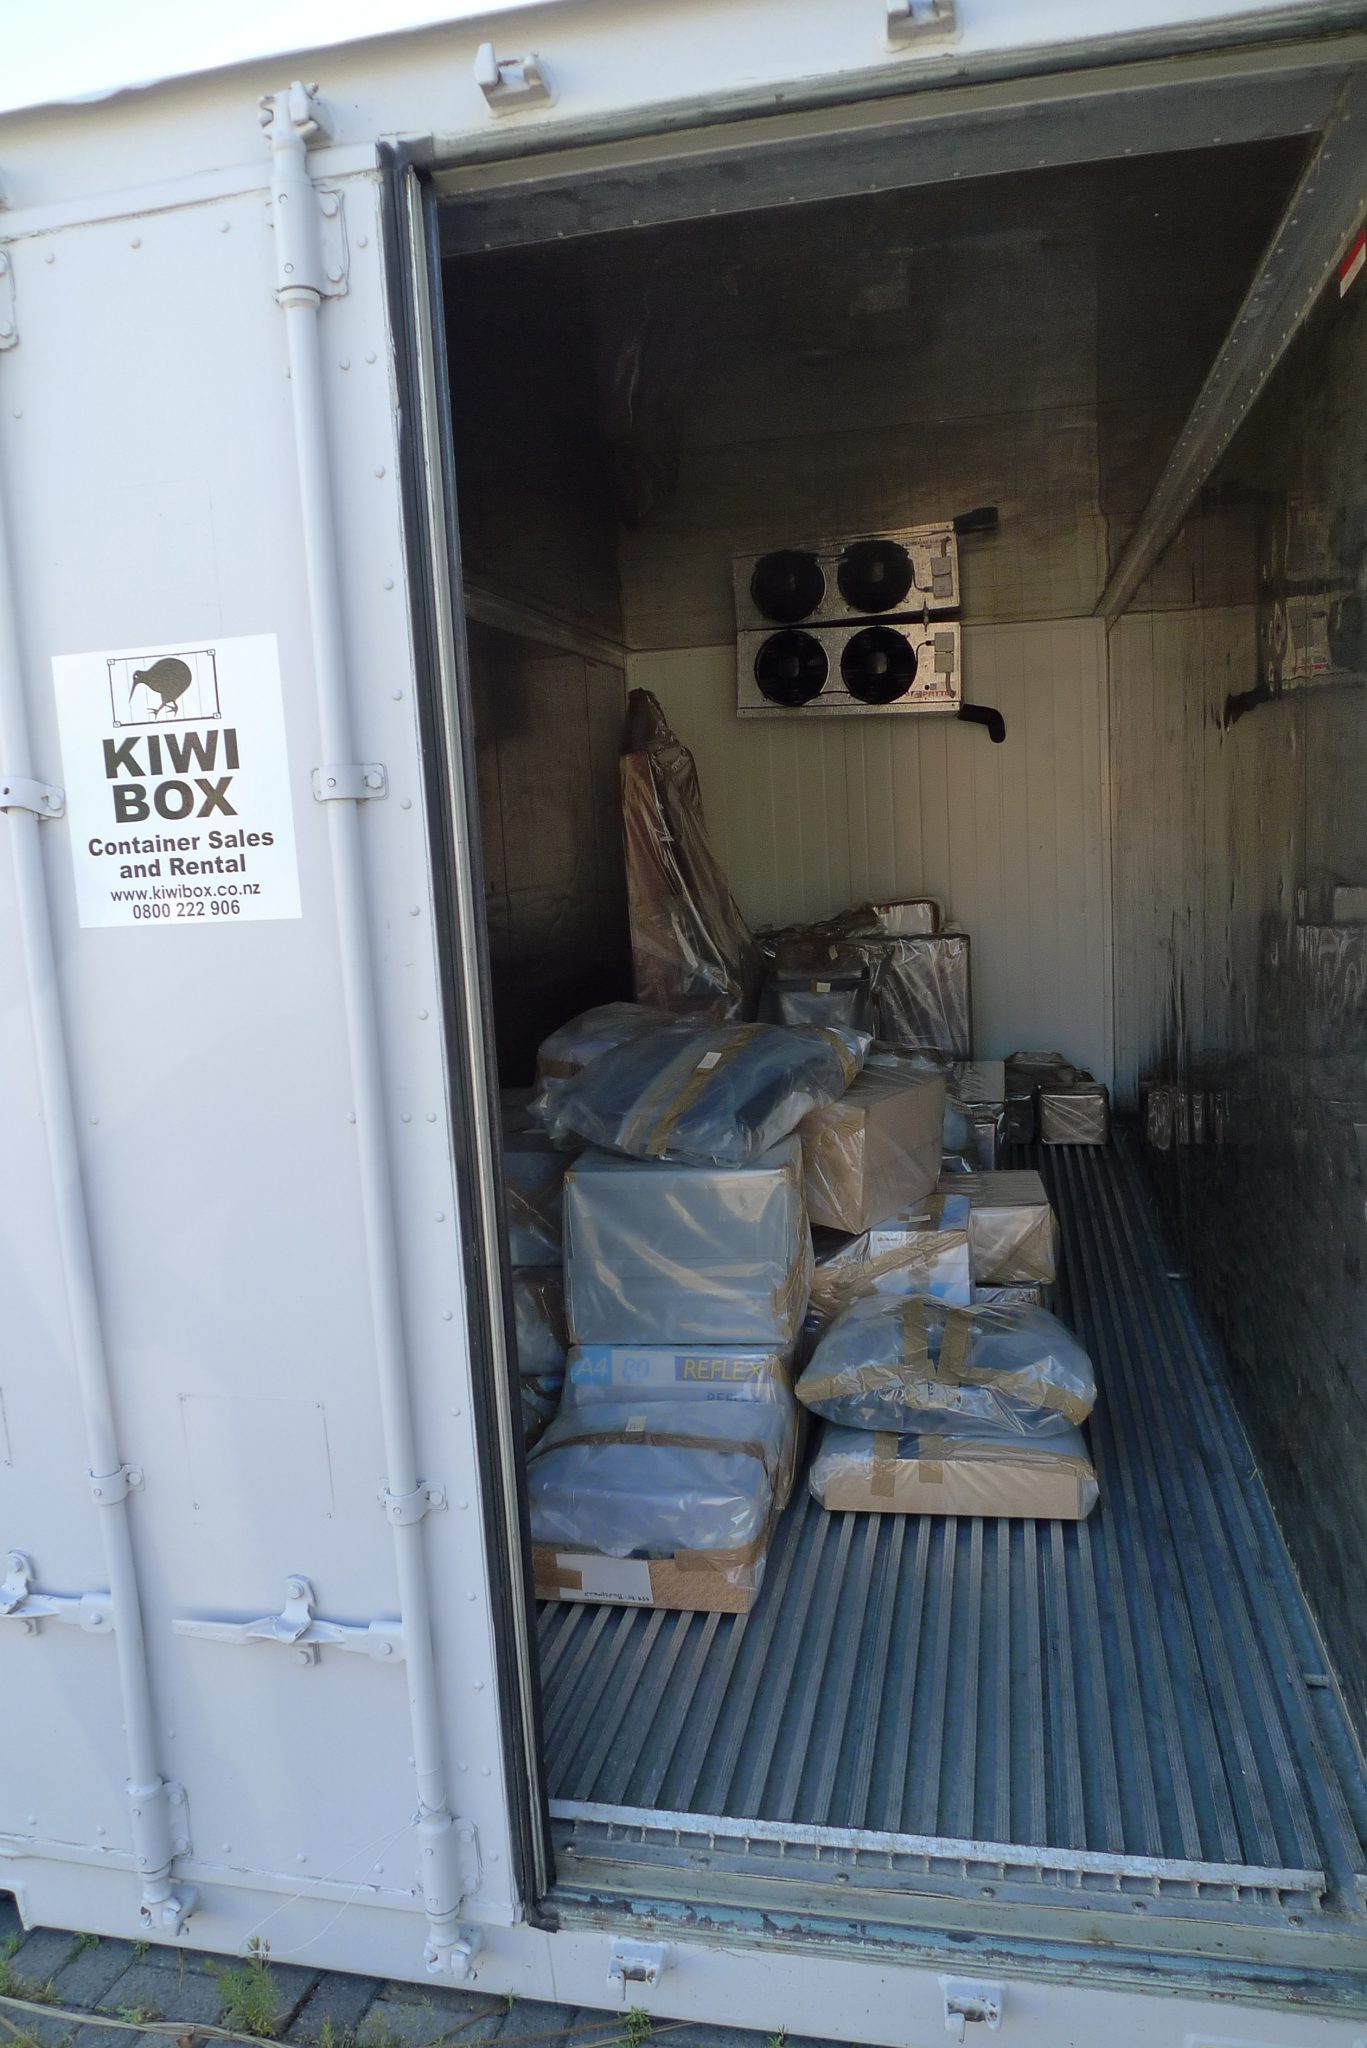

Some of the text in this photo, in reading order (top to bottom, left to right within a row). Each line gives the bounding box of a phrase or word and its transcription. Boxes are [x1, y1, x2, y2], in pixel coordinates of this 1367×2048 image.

[102, 728, 240, 779] KIWI
[112, 776, 238, 823] BOX
[88, 829, 275, 857] Container Sales
[119, 854, 246, 879] and Rental
[110, 883, 261, 902] www.kiwibox.co.nz
[132, 900, 241, 919] 0800 222 906
[575, 1356, 649, 1379] A4 80
[683, 1358, 764, 1381] REFLEX
